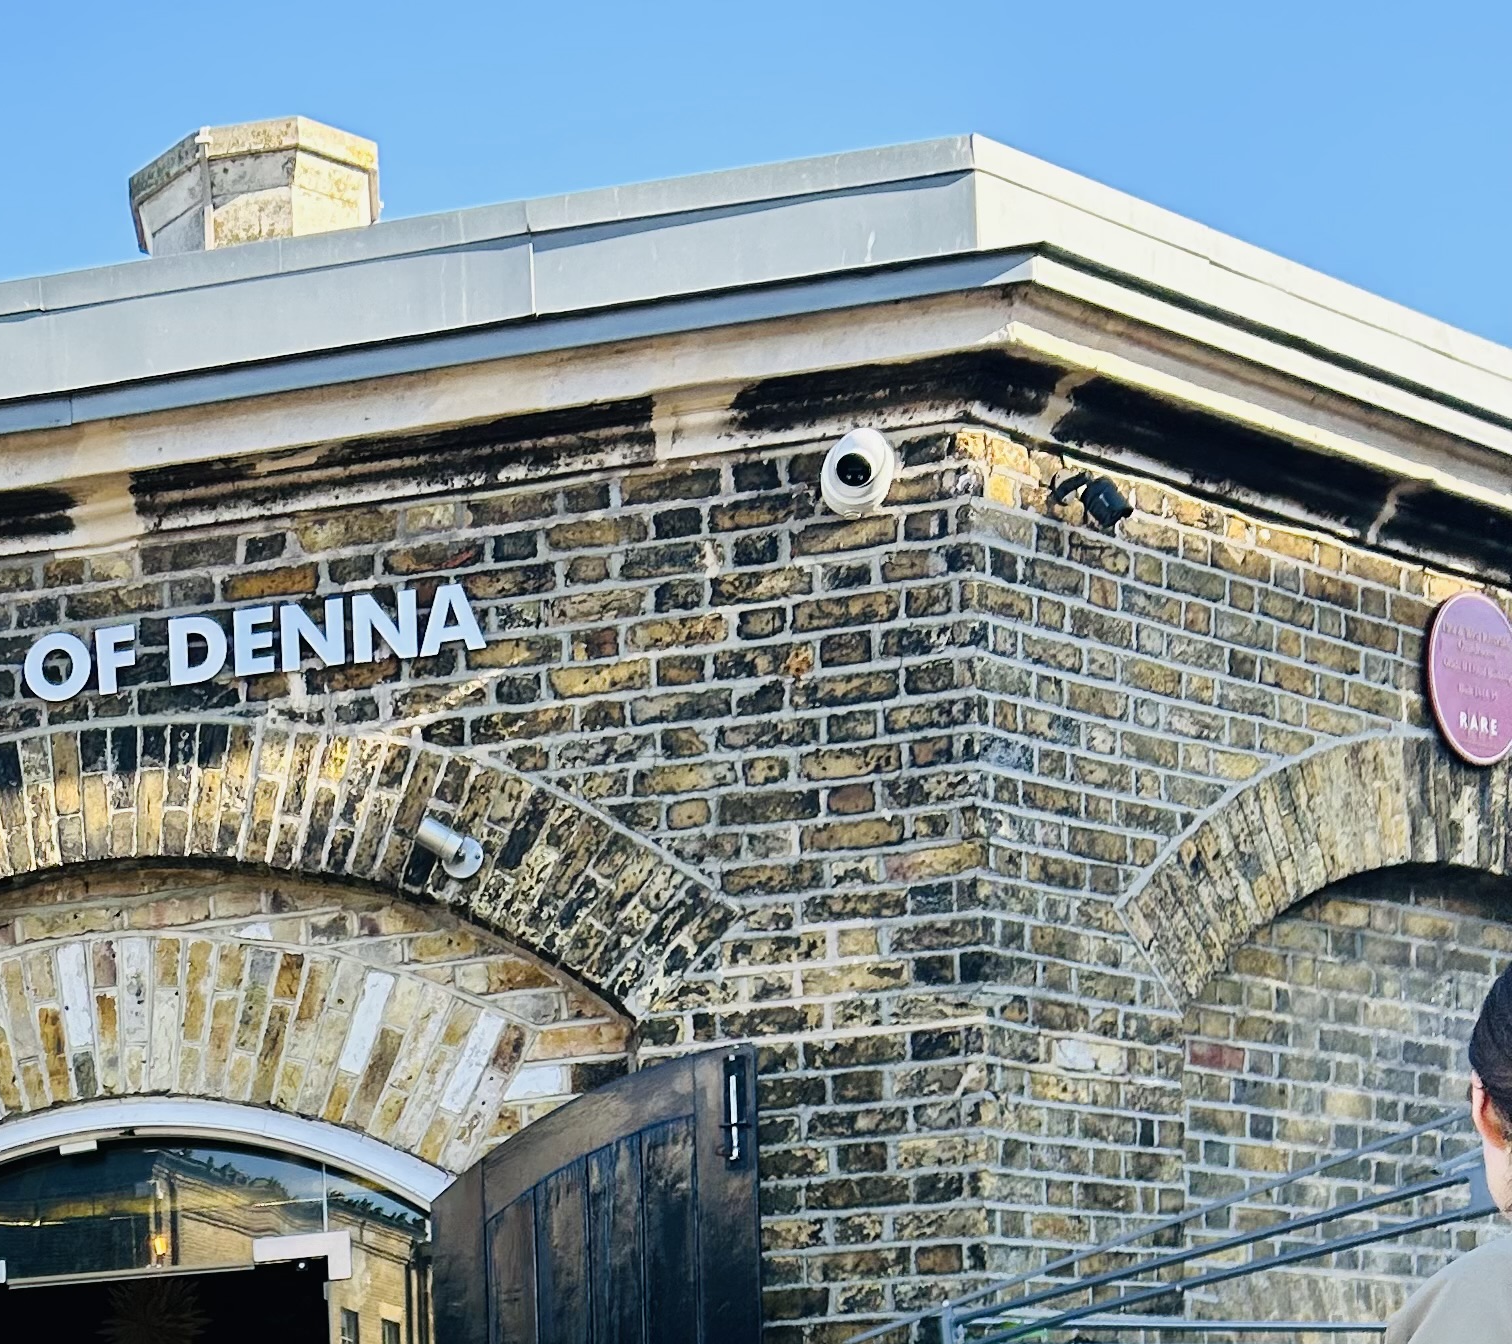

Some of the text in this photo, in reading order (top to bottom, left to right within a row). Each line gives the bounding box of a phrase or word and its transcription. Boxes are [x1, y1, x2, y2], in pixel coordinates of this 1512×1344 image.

[24, 624, 135, 702] OF
[167, 583, 487, 686] DENNA
[1459, 710, 1497, 736] RARE
